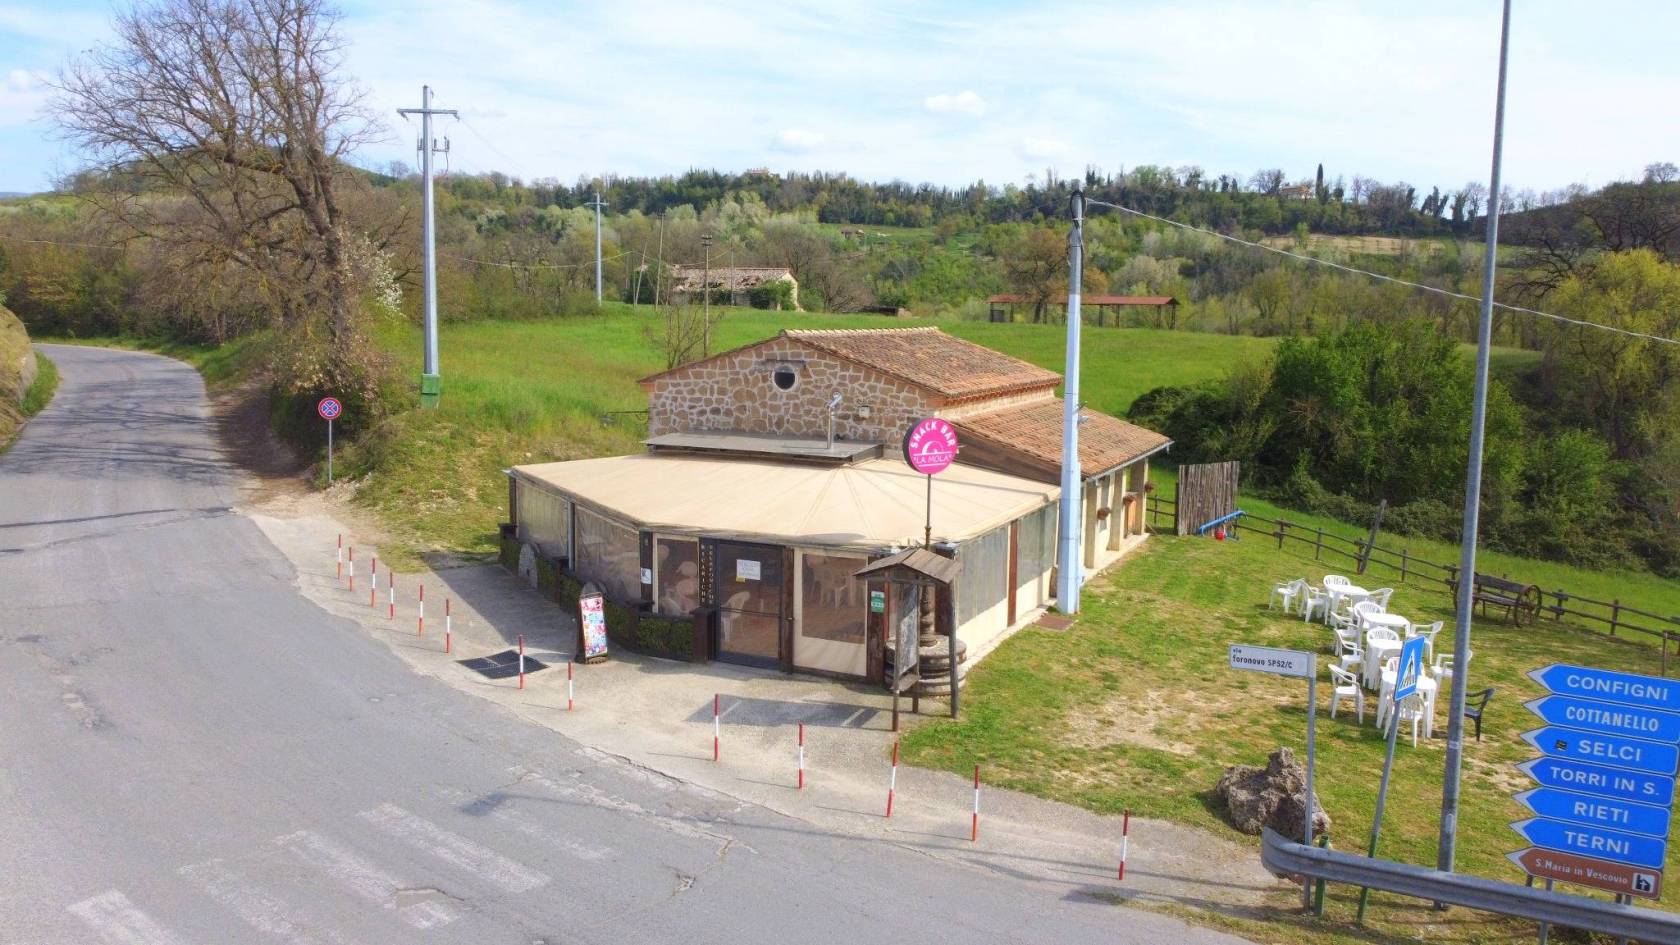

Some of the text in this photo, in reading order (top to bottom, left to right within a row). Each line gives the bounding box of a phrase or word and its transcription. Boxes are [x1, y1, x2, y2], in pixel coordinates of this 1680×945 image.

[911, 420, 956, 449] SNACK BAR
[1567, 674, 1669, 701] CONFIGNI
[1566, 706, 1659, 732] COTTANELLO
[1578, 740, 1642, 762] SELCI
[1550, 766, 1659, 796] TORRI IN S.
[1574, 801, 1629, 824] RIETI
[1565, 830, 1630, 855] TERNI
[1574, 867, 1583, 875] in
[1586, 868, 1629, 885] Vescovio
